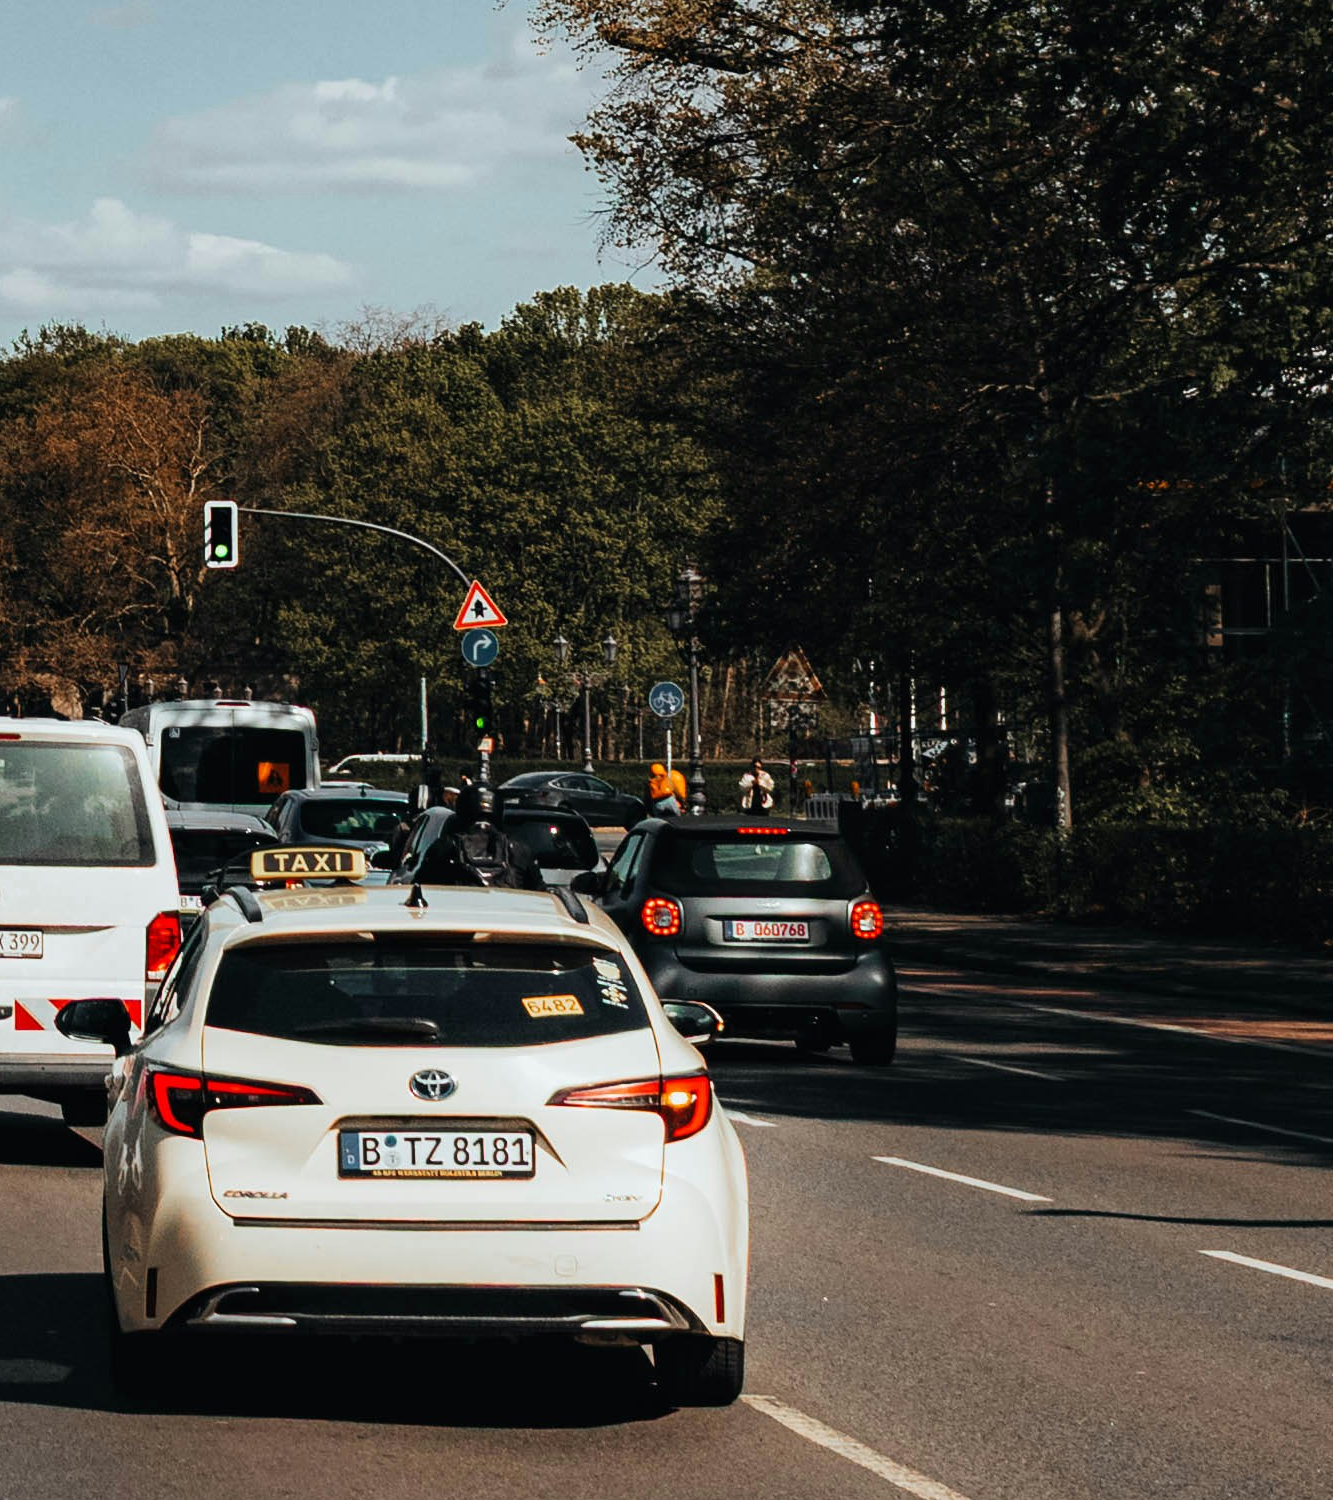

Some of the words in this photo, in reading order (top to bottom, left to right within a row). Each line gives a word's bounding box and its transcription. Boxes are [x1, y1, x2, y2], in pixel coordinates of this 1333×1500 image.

[274, 854, 341, 871] TAXI
[754, 922, 805, 937] 060768
[9, 934, 40, 951] 399
[528, 1000, 578, 1013] 6482
[363, 1138, 380, 1165] B
[404, 1138, 443, 1165] TZ
[453, 1138, 529, 1165] 8181
